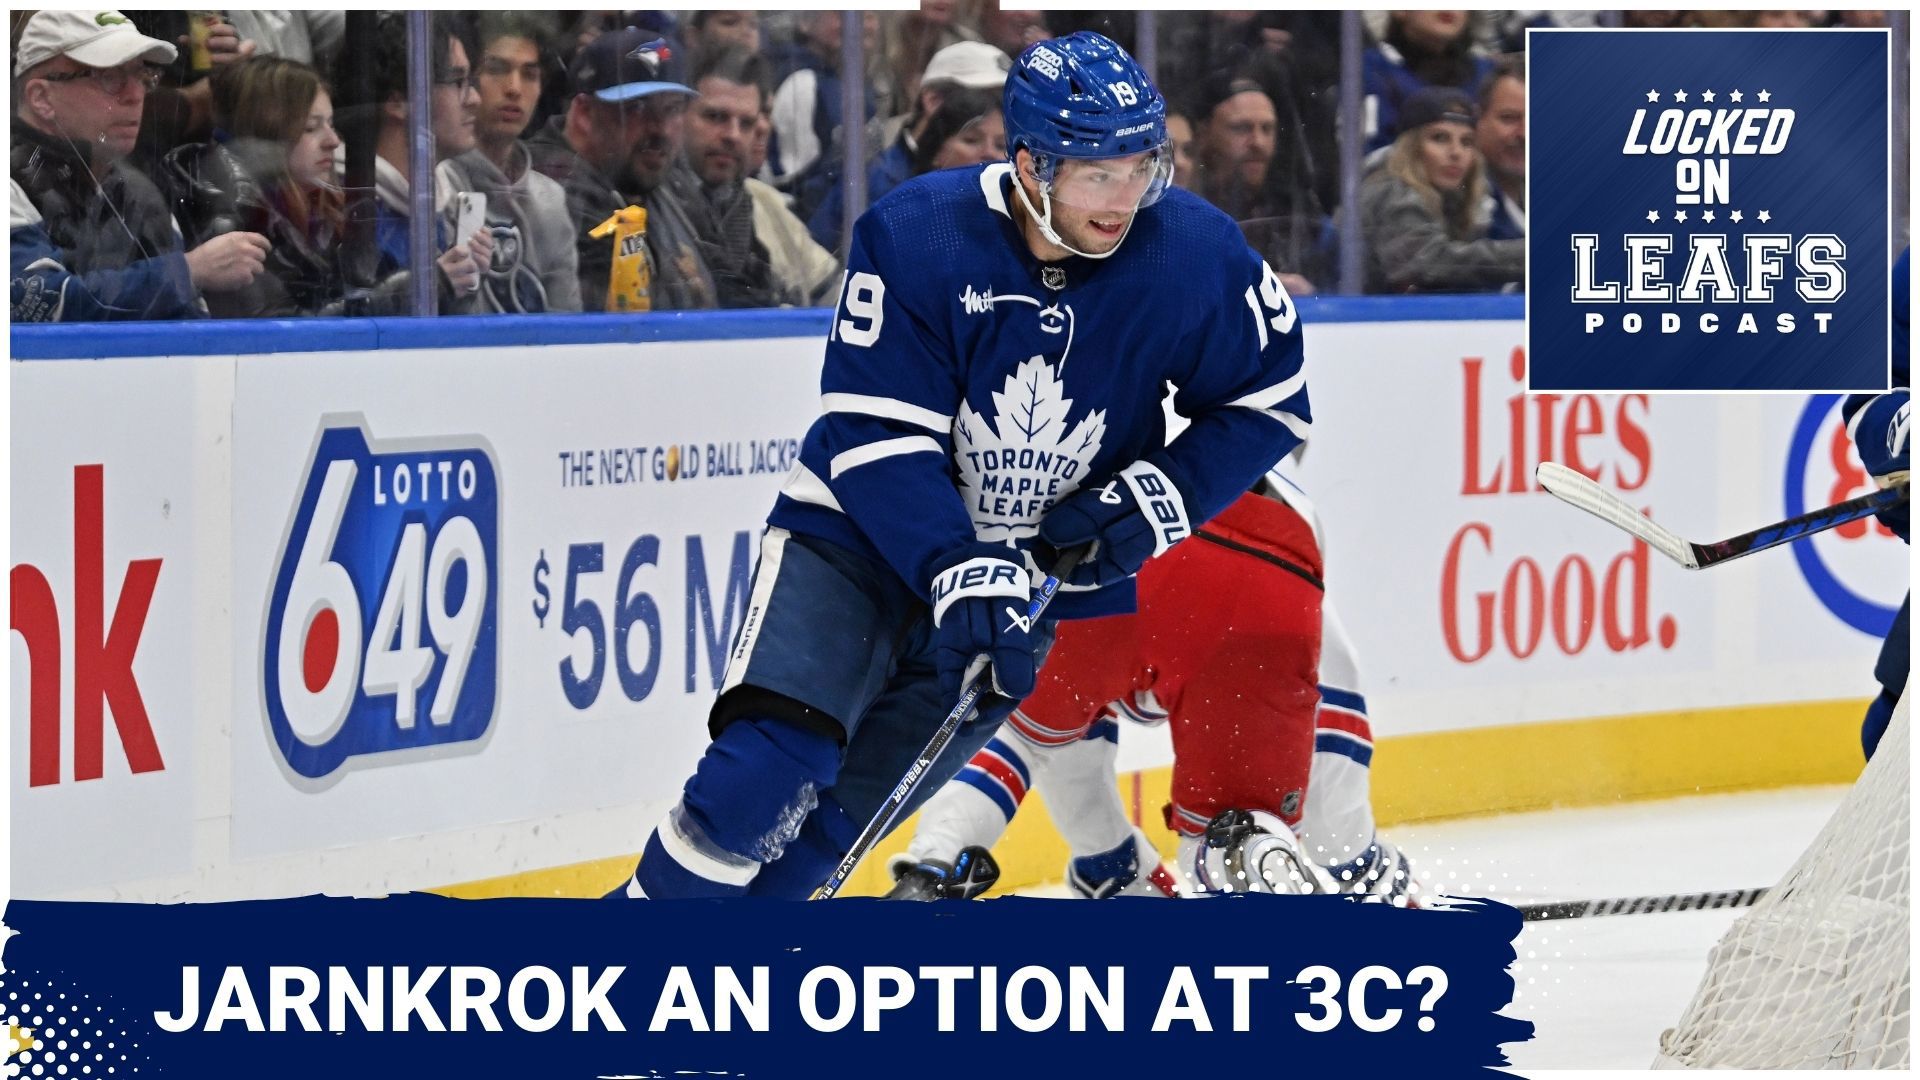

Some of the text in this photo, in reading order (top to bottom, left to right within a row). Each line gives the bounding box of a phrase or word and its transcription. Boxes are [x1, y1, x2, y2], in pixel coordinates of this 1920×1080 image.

[1027, 56, 1060, 81] pizza
[1031, 45, 1063, 67] pizza
[1108, 81, 1137, 107] 19
[1244, 259, 1298, 352] 19
[558, 437, 806, 487] THE NEXT GOLD BALL JACKP
[966, 448, 1080, 481] TORONTO
[374, 459, 477, 505] LOTTO
[981, 473, 1061, 497] MAPLE
[978, 494, 1056, 519] LEAFS
[1440, 506, 1679, 665] Good.
